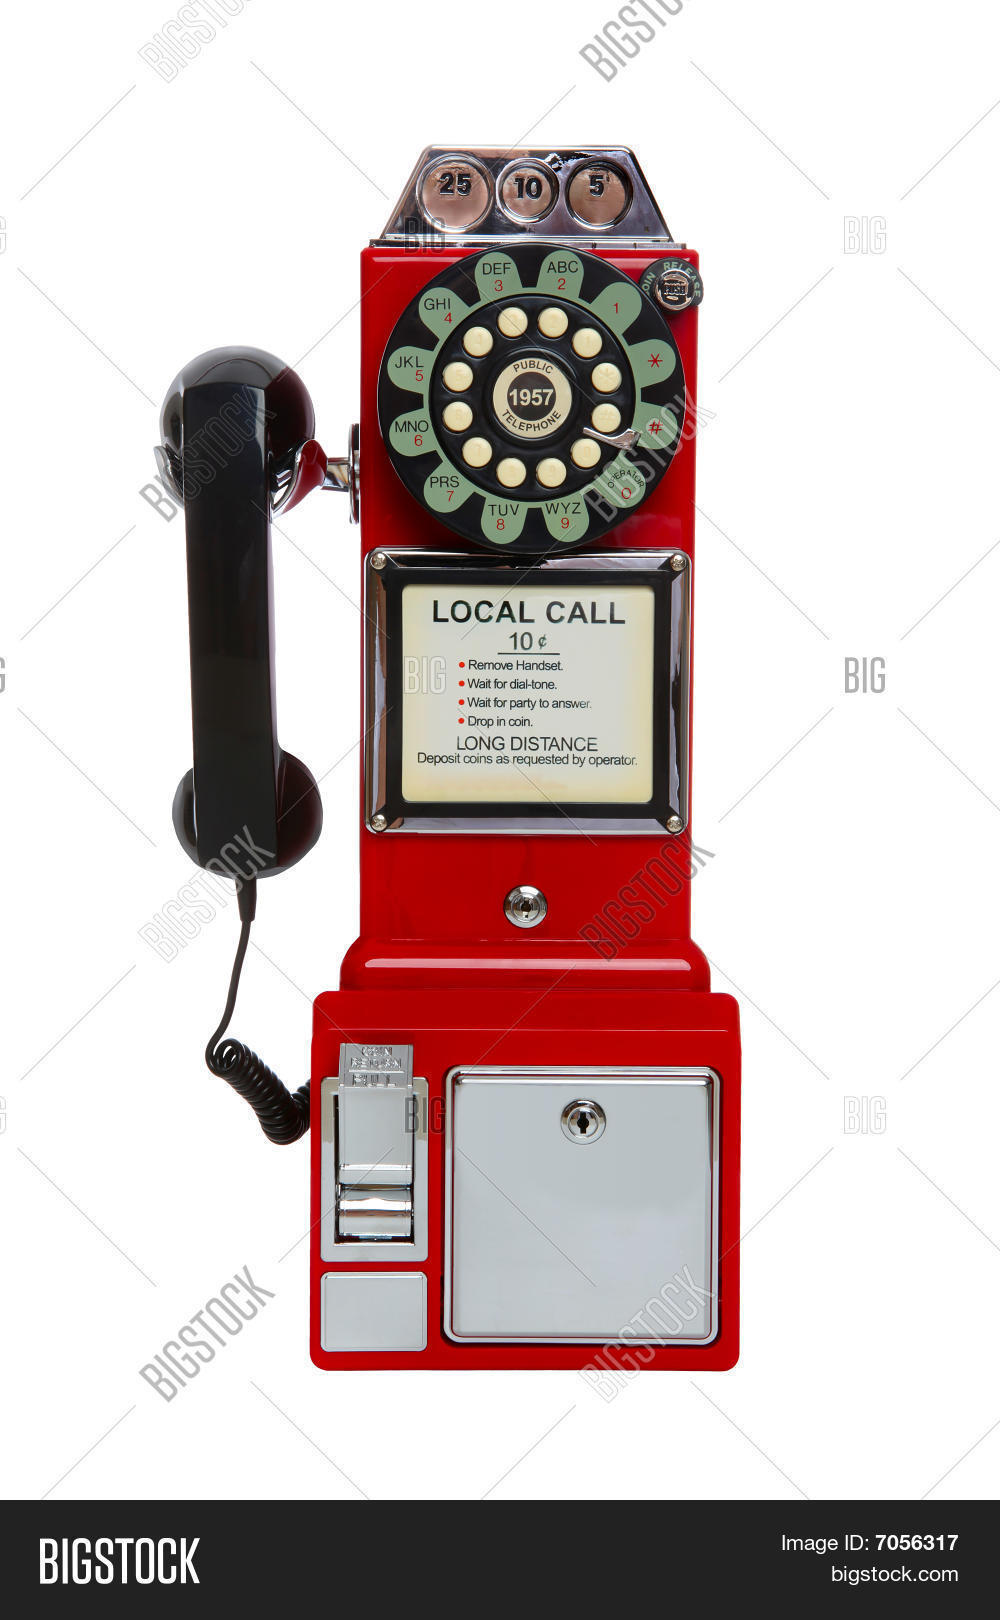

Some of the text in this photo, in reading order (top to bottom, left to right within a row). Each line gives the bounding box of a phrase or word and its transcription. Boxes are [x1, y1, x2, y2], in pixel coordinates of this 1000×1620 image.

[439, 172, 472, 196] 25
[514, 176, 543, 199] 10
[482, 262, 512, 275] DEF
[547, 260, 579, 274] ABC
[494, 280, 503, 292] 3
[557, 278, 566, 290] 2
[423, 298, 451, 310] GHI
[613, 302, 619, 313] 1
[444, 313, 453, 324] 4
[395, 356, 424, 368] JKL
[512, 359, 554, 374] PUBLIC
[415, 370, 424, 382] 5
[509, 388, 554, 406] 1957
[501, 408, 561, 432] TELEPHONE
[395, 420, 429, 433] MNO
[414, 434, 423, 447] 6
[430, 476, 460, 488] PRS
[446, 490, 455, 502] 7
[488, 504, 519, 516] TUV
[546, 502, 581, 514] WYZ
[496, 518, 505, 530] 8
[561, 517, 570, 529] 9
[432, 600, 626, 624] LOCAL CALL
[509, 632, 533, 651] 10
[468, 660, 563, 671] Remove Handset.
[467, 679, 557, 690] Wait for dial-tone.
[467, 697, 592, 711] Wait for party to answer.
[467, 716, 534, 729] Drop in coin.
[456, 736, 598, 752] LONG DISTANCE
[417, 752, 638, 768] Deposit coins as requested by operator.
